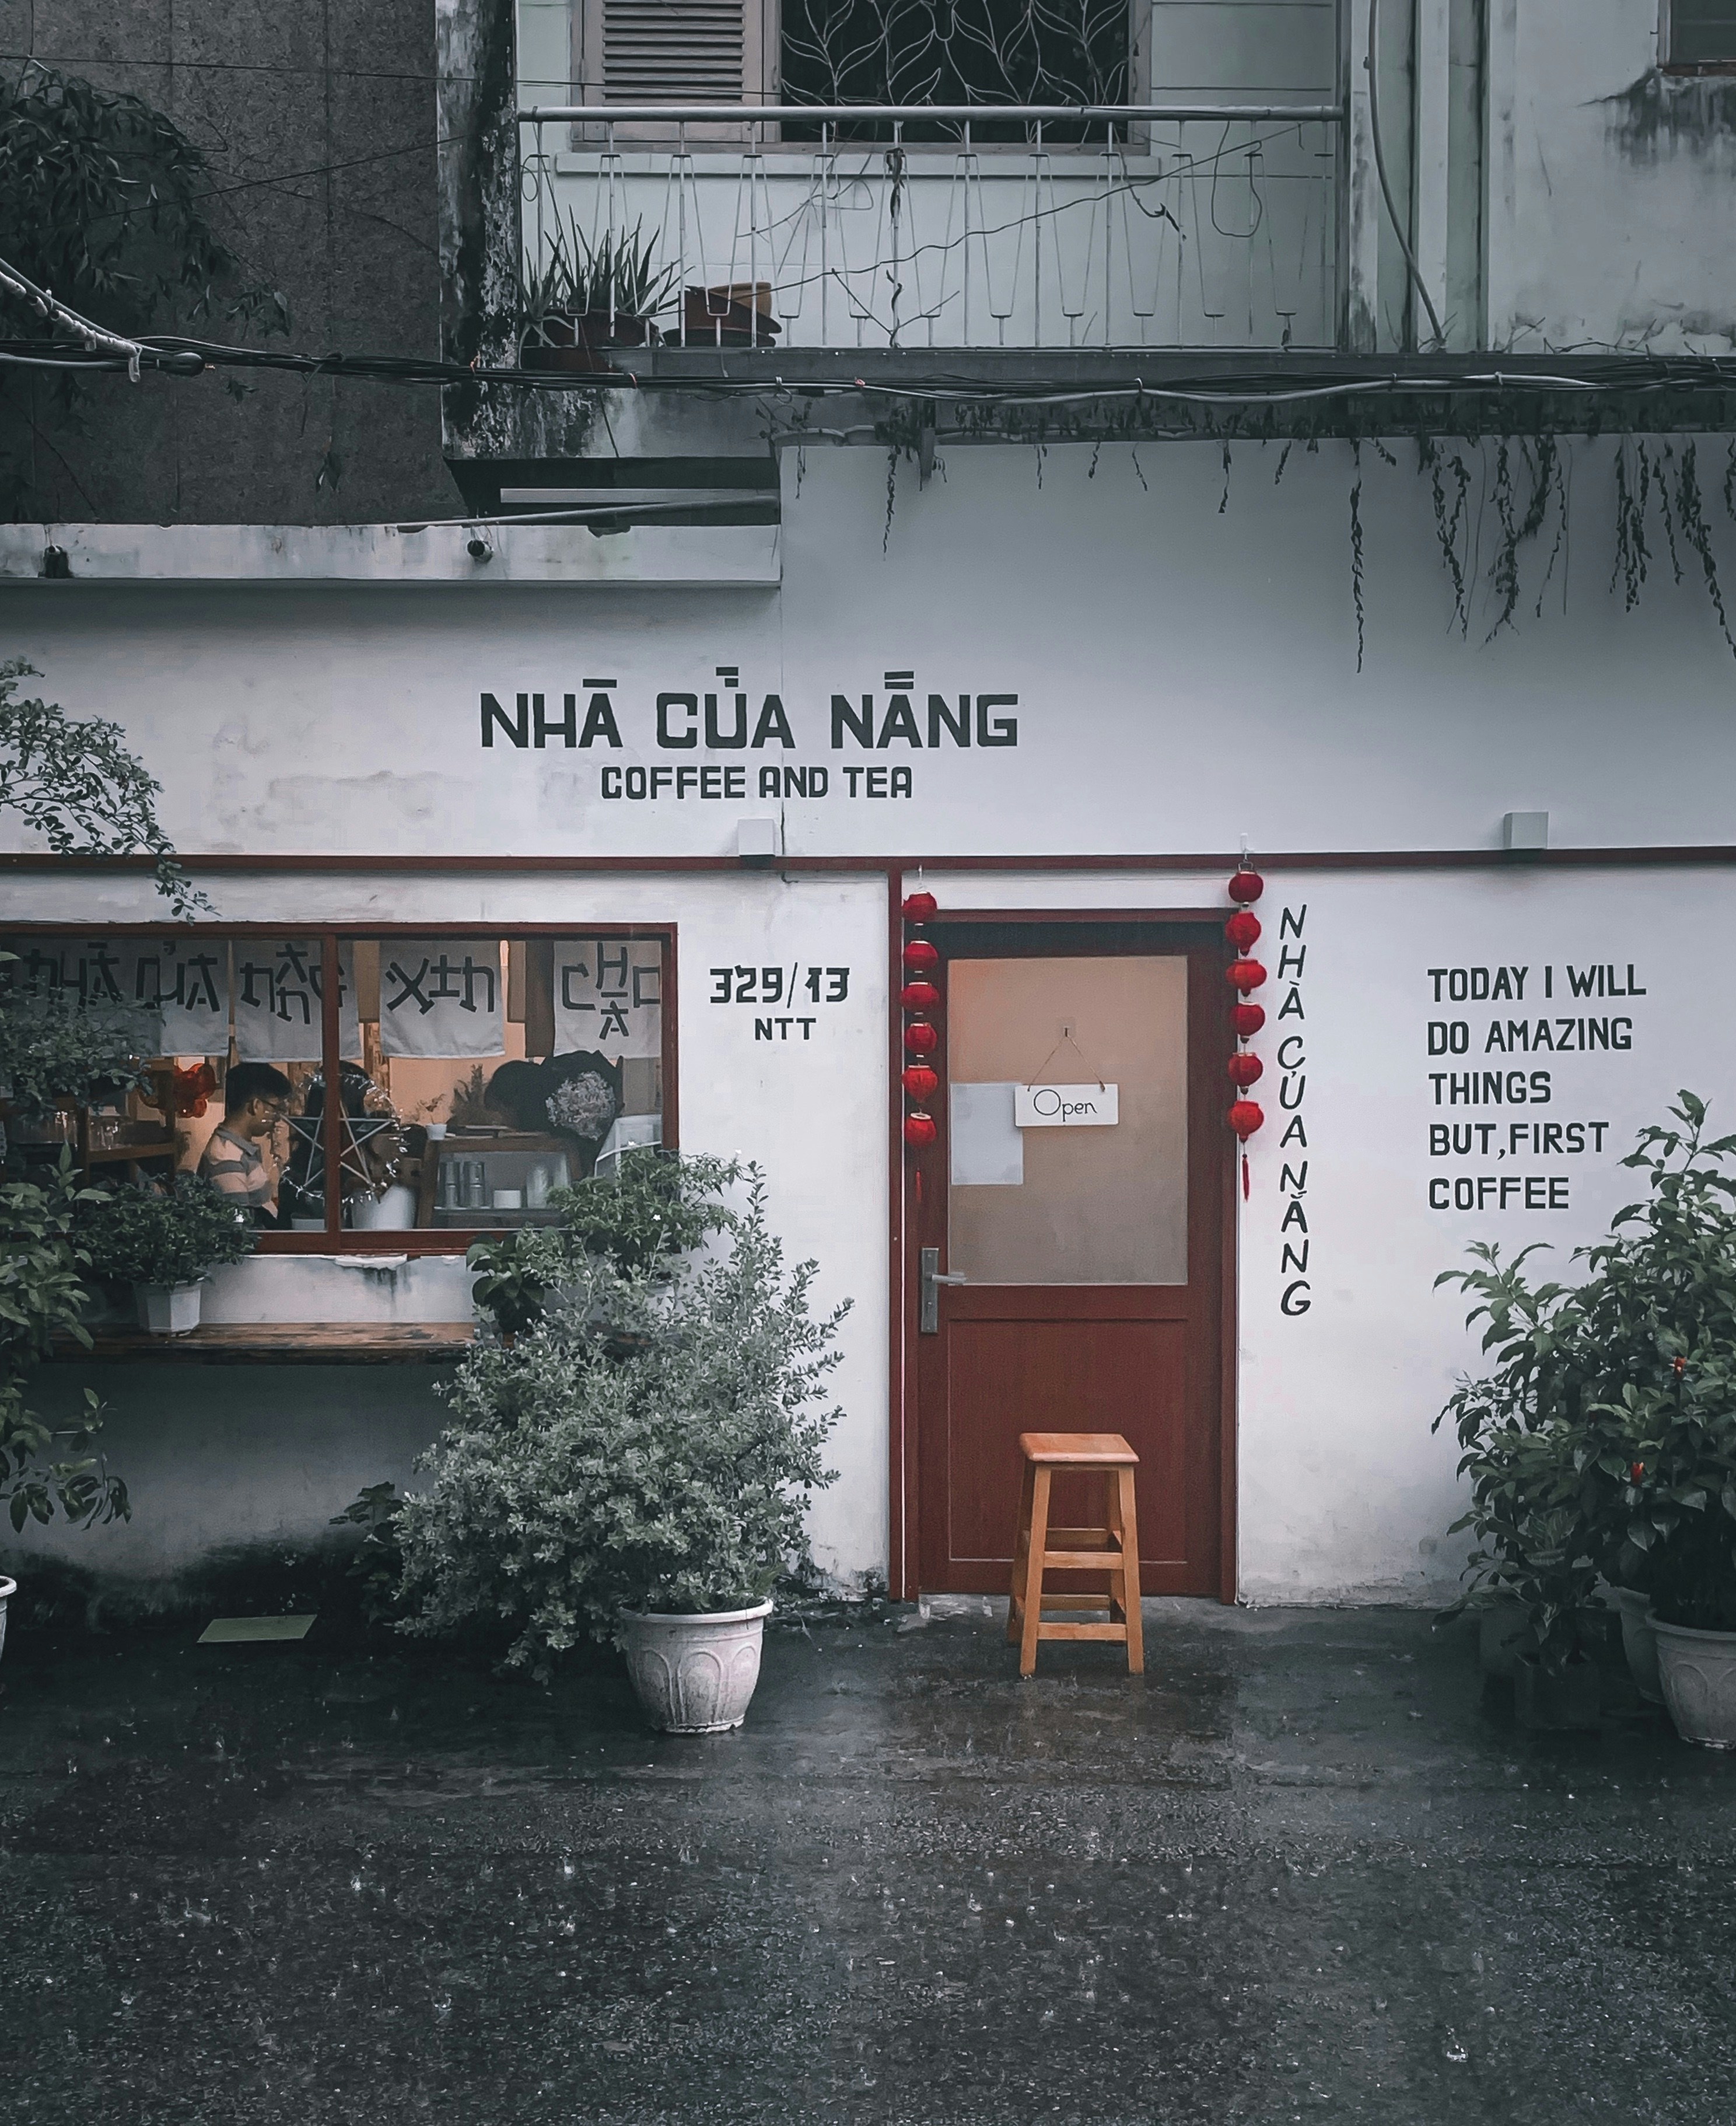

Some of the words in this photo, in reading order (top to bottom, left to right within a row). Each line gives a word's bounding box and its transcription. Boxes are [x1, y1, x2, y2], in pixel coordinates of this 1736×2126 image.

[601, 765, 746, 800] COFFEE
[759, 766, 828, 798] AND
[842, 766, 912, 799] TEA
[710, 962, 850, 1009] 329/13
[1427, 966, 1529, 1002] TODAY
[1545, 966, 1552, 998] I
[1566, 964, 1647, 998] WILL
[755, 1017, 816, 1040] NTT
[1427, 1021, 1469, 1056] DO
[1485, 1017, 1633, 1053] AMAZING
[1428, 1071, 1551, 1105] THINGS
[1033, 1089, 1097, 1123] Open
[1429, 1177, 1569, 1210] COFFEE
